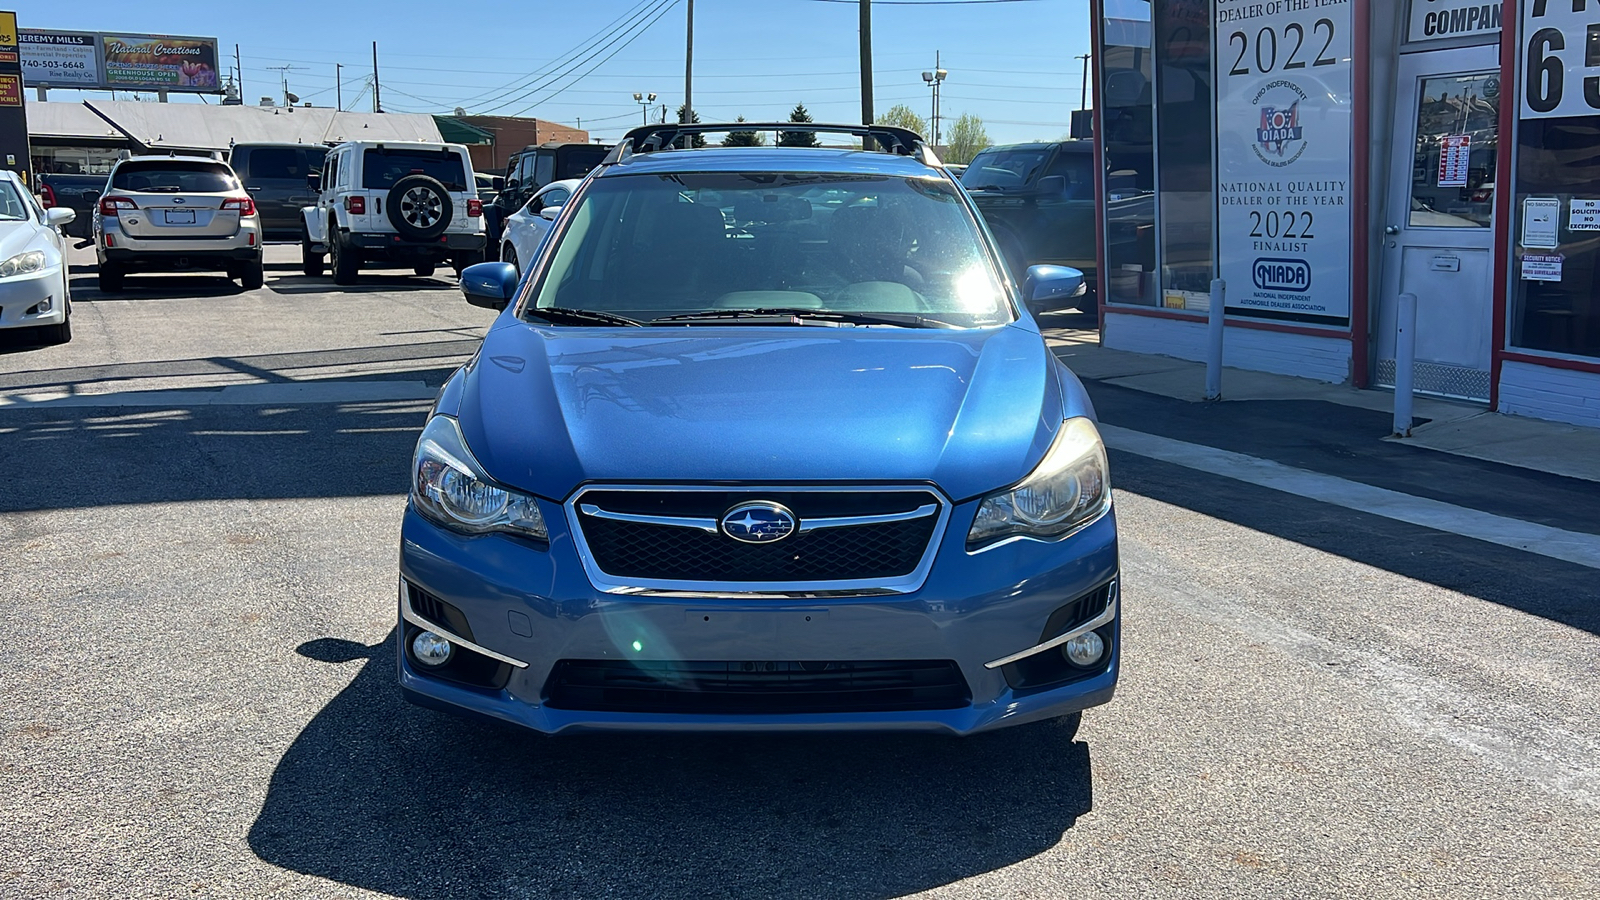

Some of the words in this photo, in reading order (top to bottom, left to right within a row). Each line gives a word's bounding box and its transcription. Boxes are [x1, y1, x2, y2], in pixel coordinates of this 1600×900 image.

[1219, 4, 1263, 23] DEALER
[1266, 1, 1282, 15] OF
[1285, 0, 1309, 12] THE
[18, 34, 54, 43] JEREMY
[56, 35, 84, 44] MILLS
[109, 42, 152, 54] Natural
[153, 43, 201, 56] Creations
[1228, 18, 1336, 76] 2022
[22, 60, 85, 69] 740-503-6648
[63, 71, 82, 79] Realty
[1252, 87, 1266, 105] OHIO
[1266, 80, 1308, 101] INDEPENDENT
[1262, 128, 1294, 140] OIADA
[1220, 182, 1282, 192] NATIONAL
[1287, 181, 1346, 193] QUALITY
[1222, 196, 1263, 206] DEALER
[1267, 196, 1281, 205] OF
[1286, 196, 1308, 205] THE
[1313, 196, 1344, 205] YEAR
[1249, 210, 1314, 239] 2022
[1253, 241, 1309, 252] FINALIST
[1257, 264, 1306, 285] NIADA
[1253, 291, 1276, 299] NATIONAL
[1277, 293, 1311, 302] INDEPENDENT
[1240, 299, 1269, 307] AUTOMOBILE
[1270, 301, 1291, 309] DEALERS
[1292, 303, 1326, 311] ASSOCIATION
